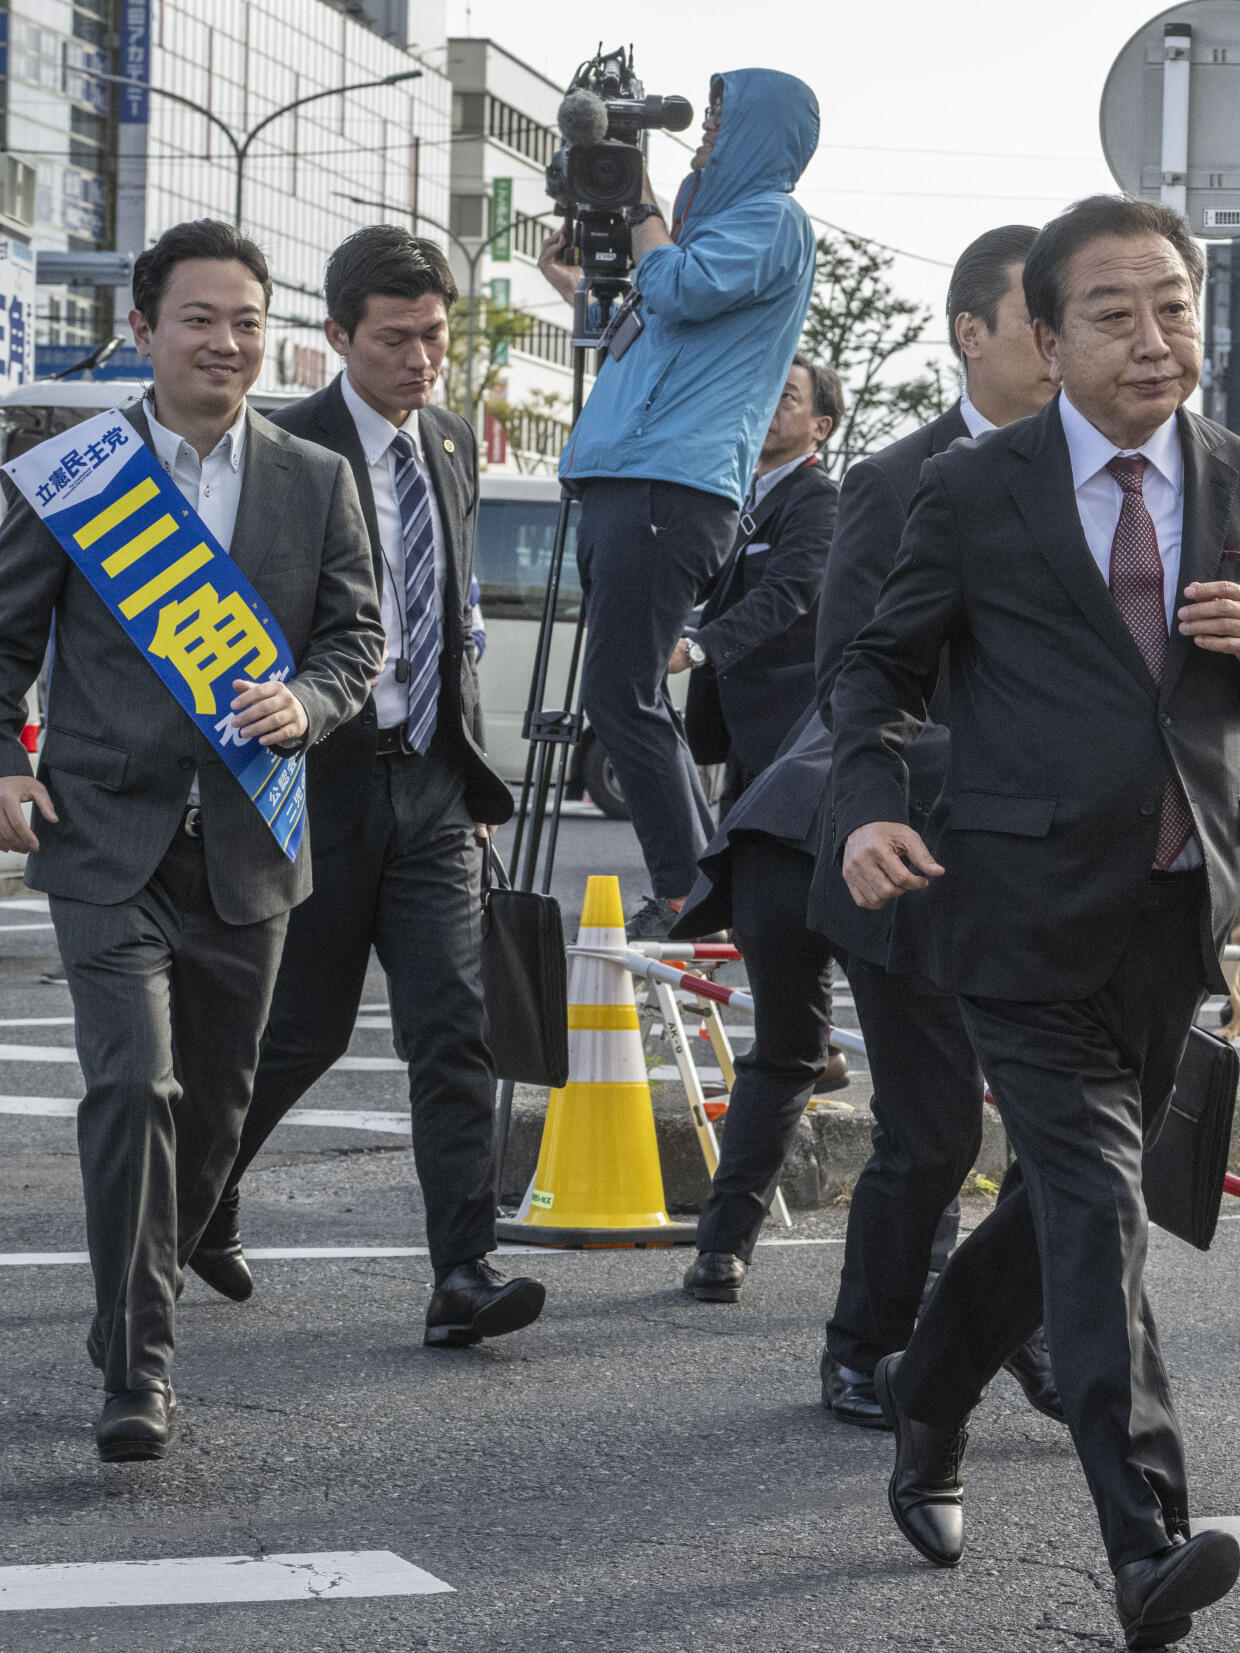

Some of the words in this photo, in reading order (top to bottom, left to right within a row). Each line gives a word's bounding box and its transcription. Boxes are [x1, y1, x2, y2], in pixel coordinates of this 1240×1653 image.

[36, 426, 129, 508] 立憲民主党
[72, 476, 279, 715] 三角
